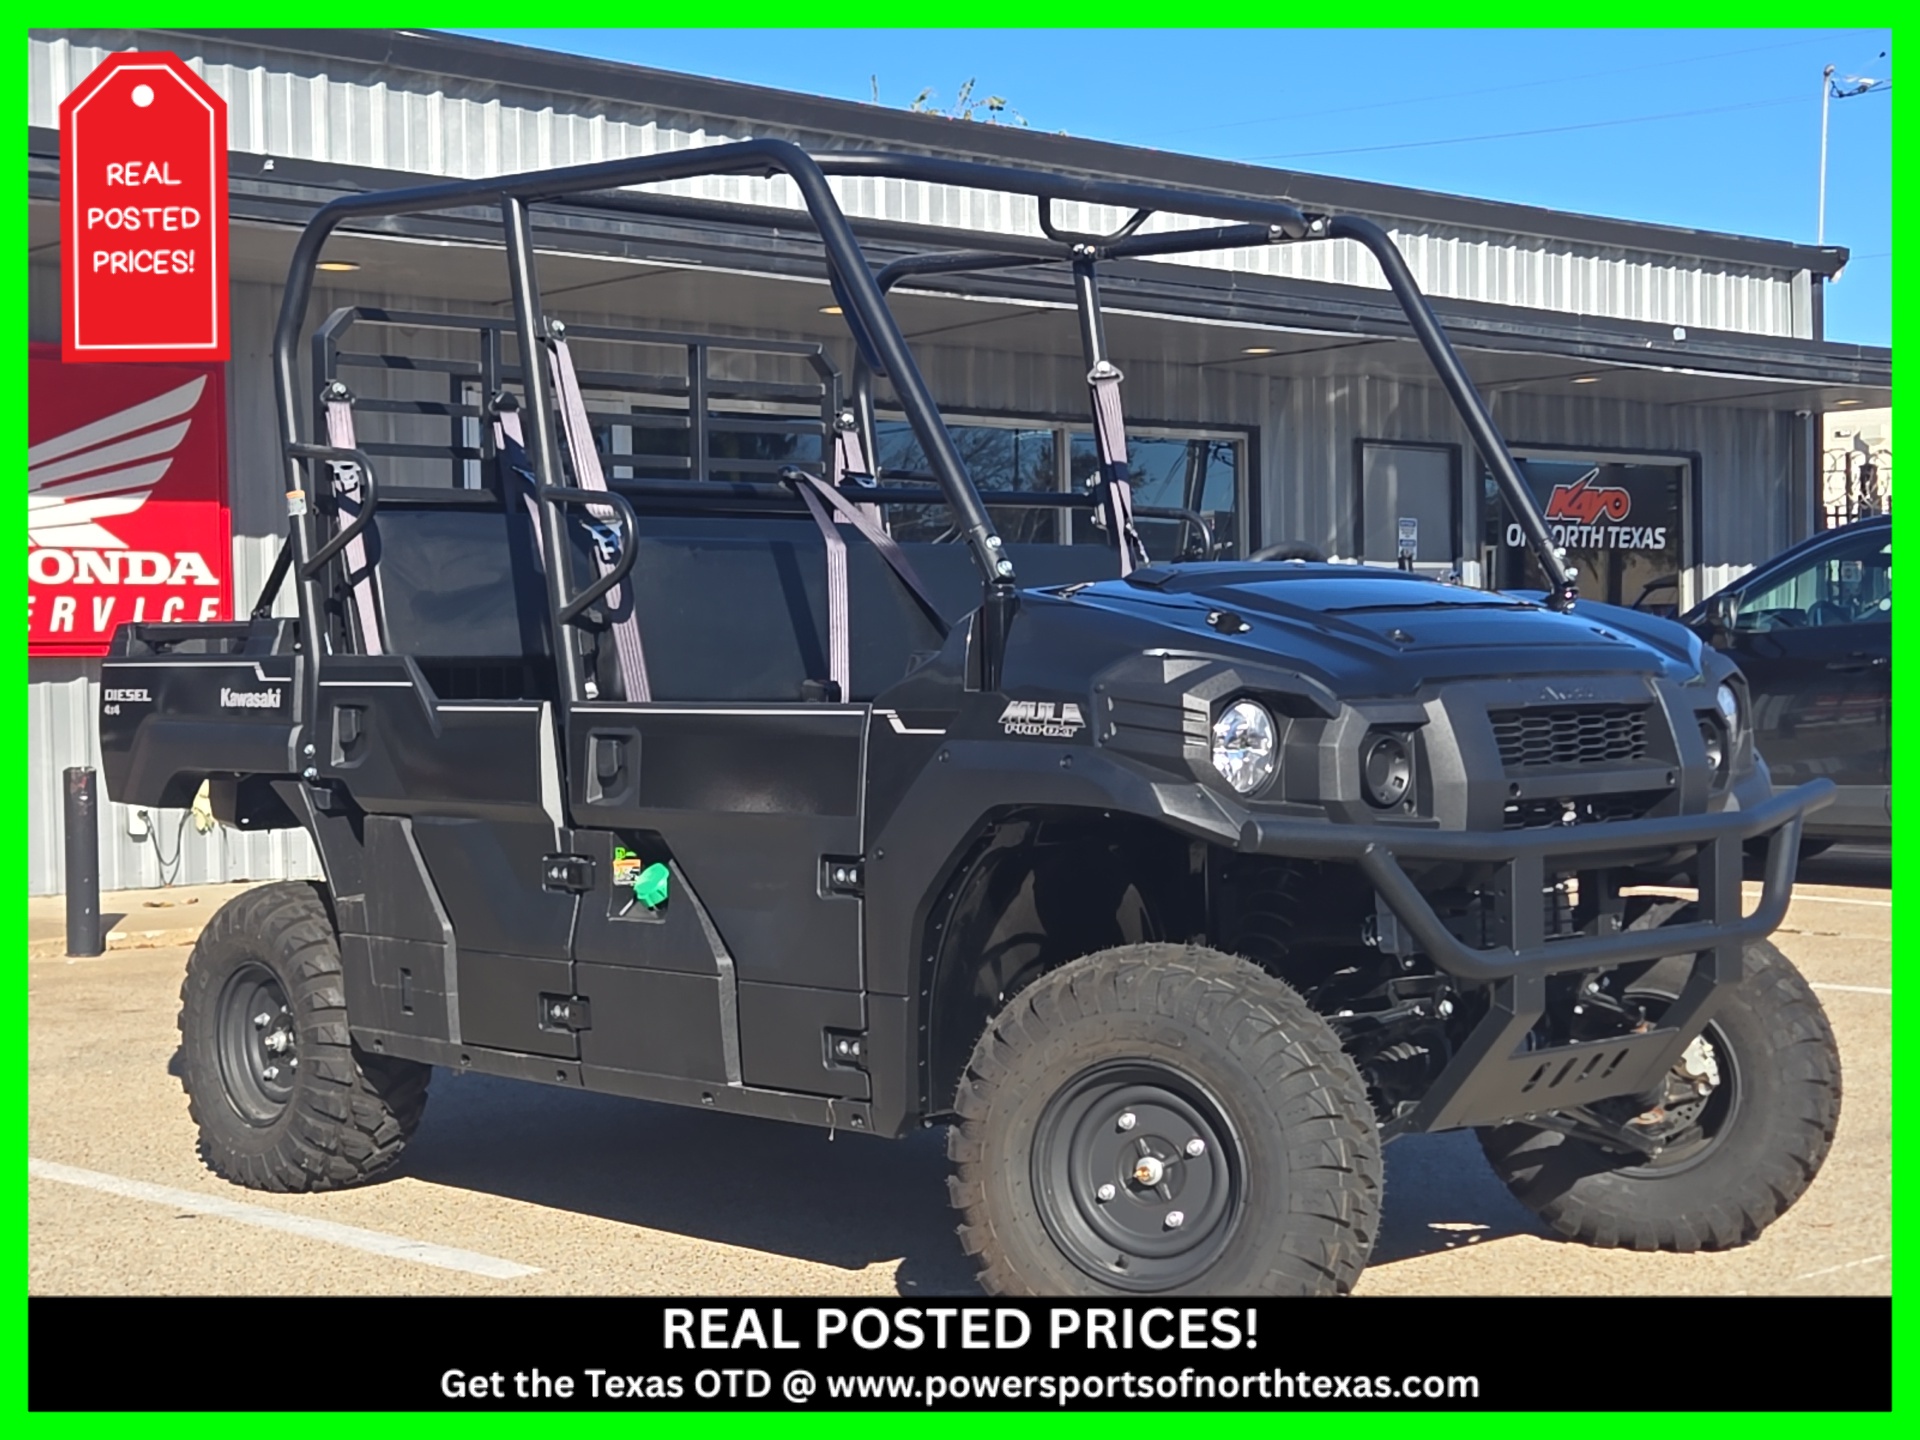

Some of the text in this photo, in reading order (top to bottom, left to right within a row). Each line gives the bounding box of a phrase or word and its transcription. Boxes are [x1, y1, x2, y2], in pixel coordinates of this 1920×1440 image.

[1546, 468, 1631, 524] KAYO
[1549, 525, 1604, 548] ORTH
[1607, 526, 1667, 549] TEXAS
[104, 689, 152, 702] DIESEL
[220, 688, 281, 708] Kawasaki
